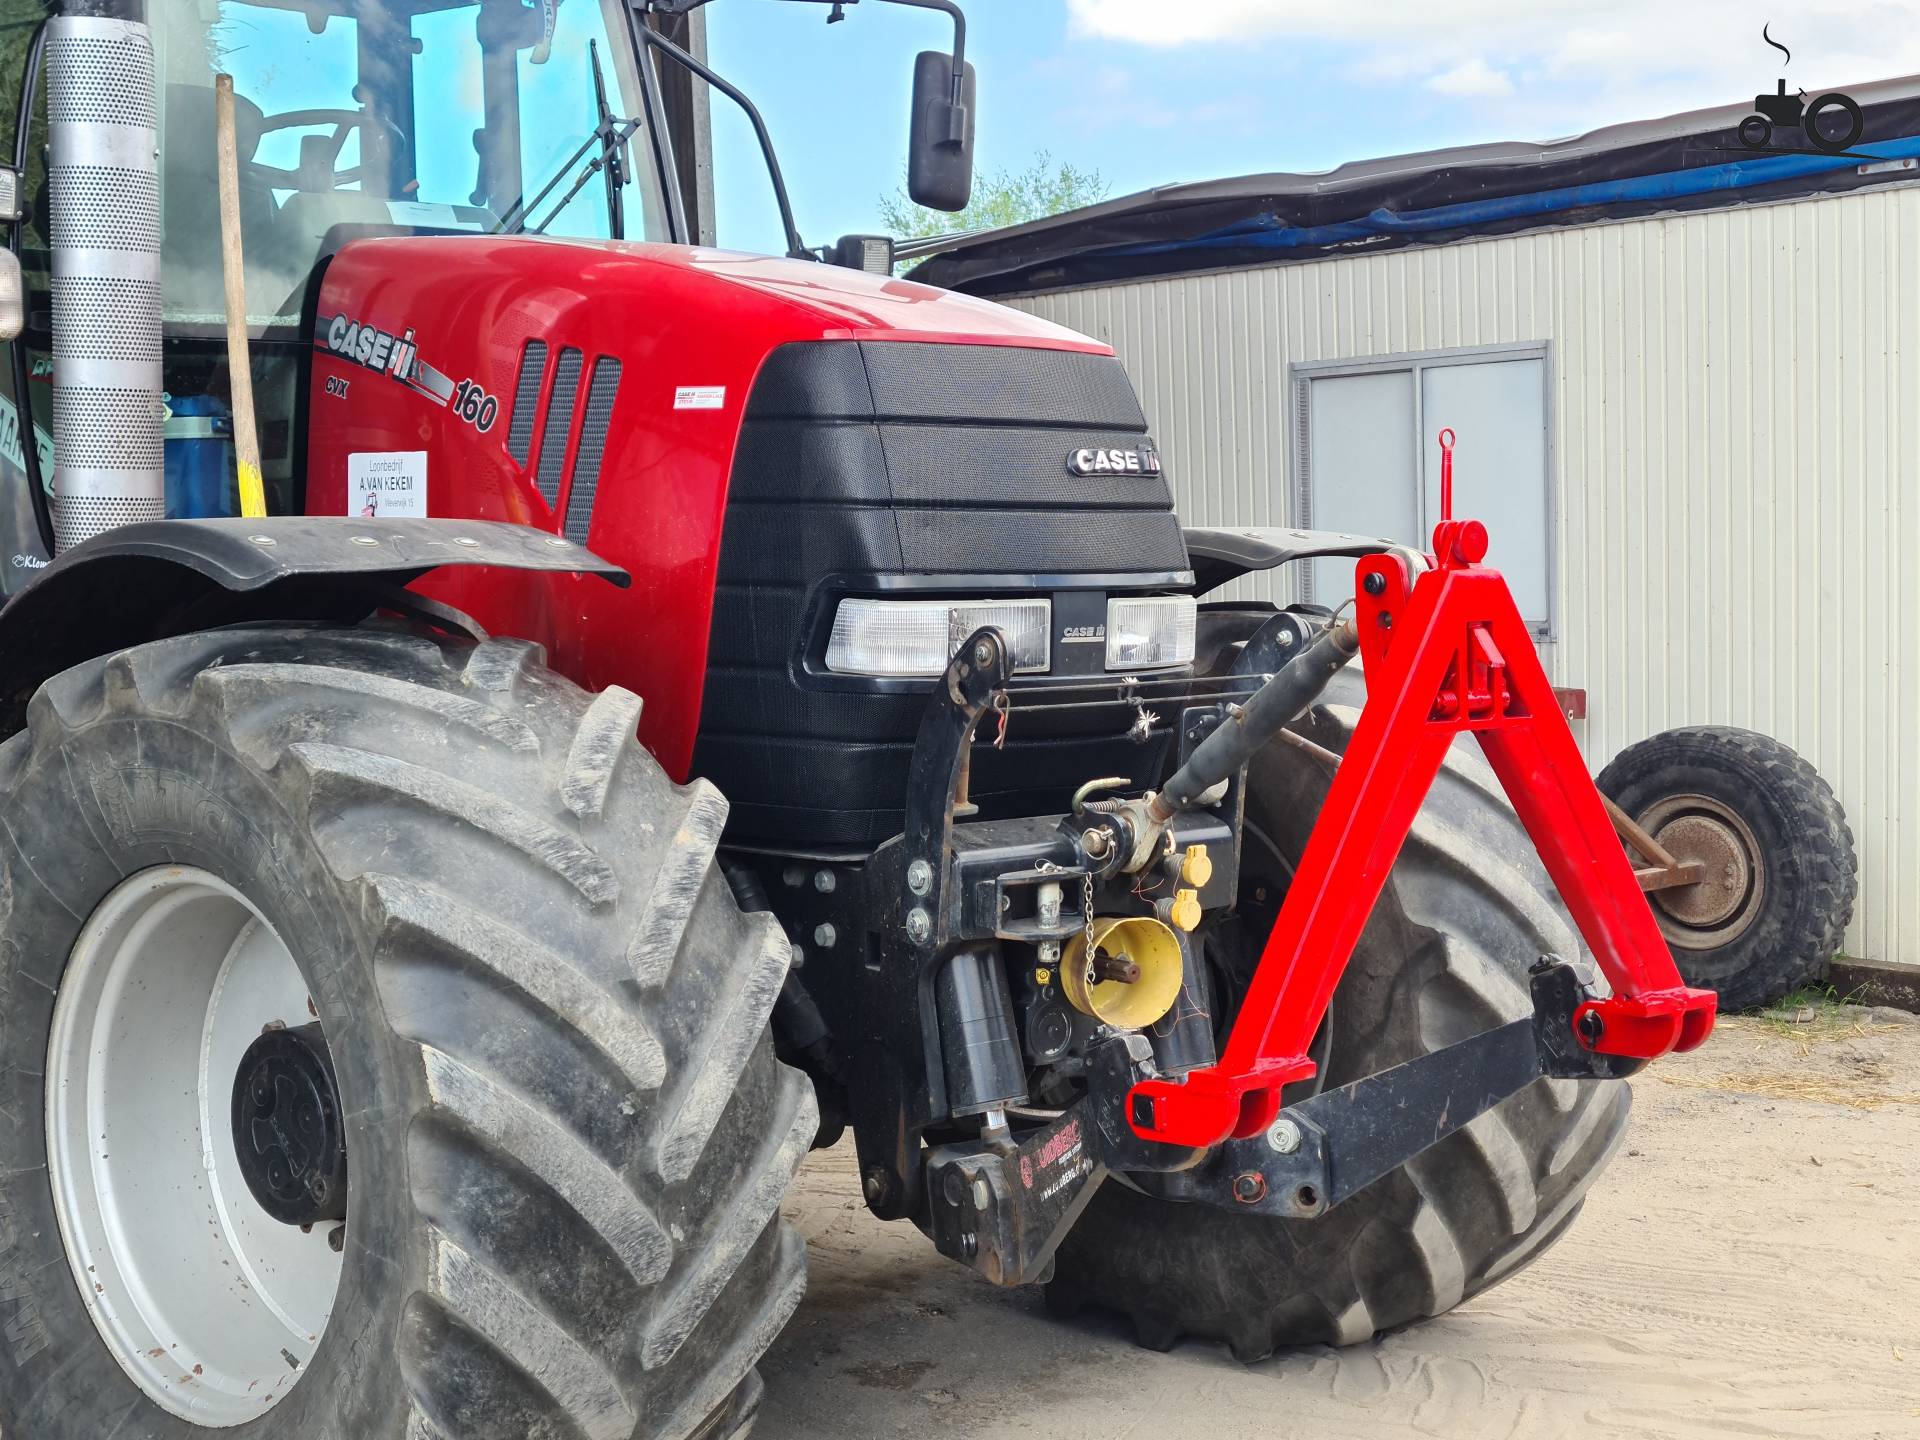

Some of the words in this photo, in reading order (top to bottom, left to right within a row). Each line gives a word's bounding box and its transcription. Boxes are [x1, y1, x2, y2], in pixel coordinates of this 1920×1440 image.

[328, 314, 393, 372] CASE
[325, 376, 350, 399] CVX
[453, 378, 499, 432] 160
[1076, 448, 1140, 471] CASE
[384, 475, 413, 491] KEKEM
[1063, 626, 1095, 638] CASE
